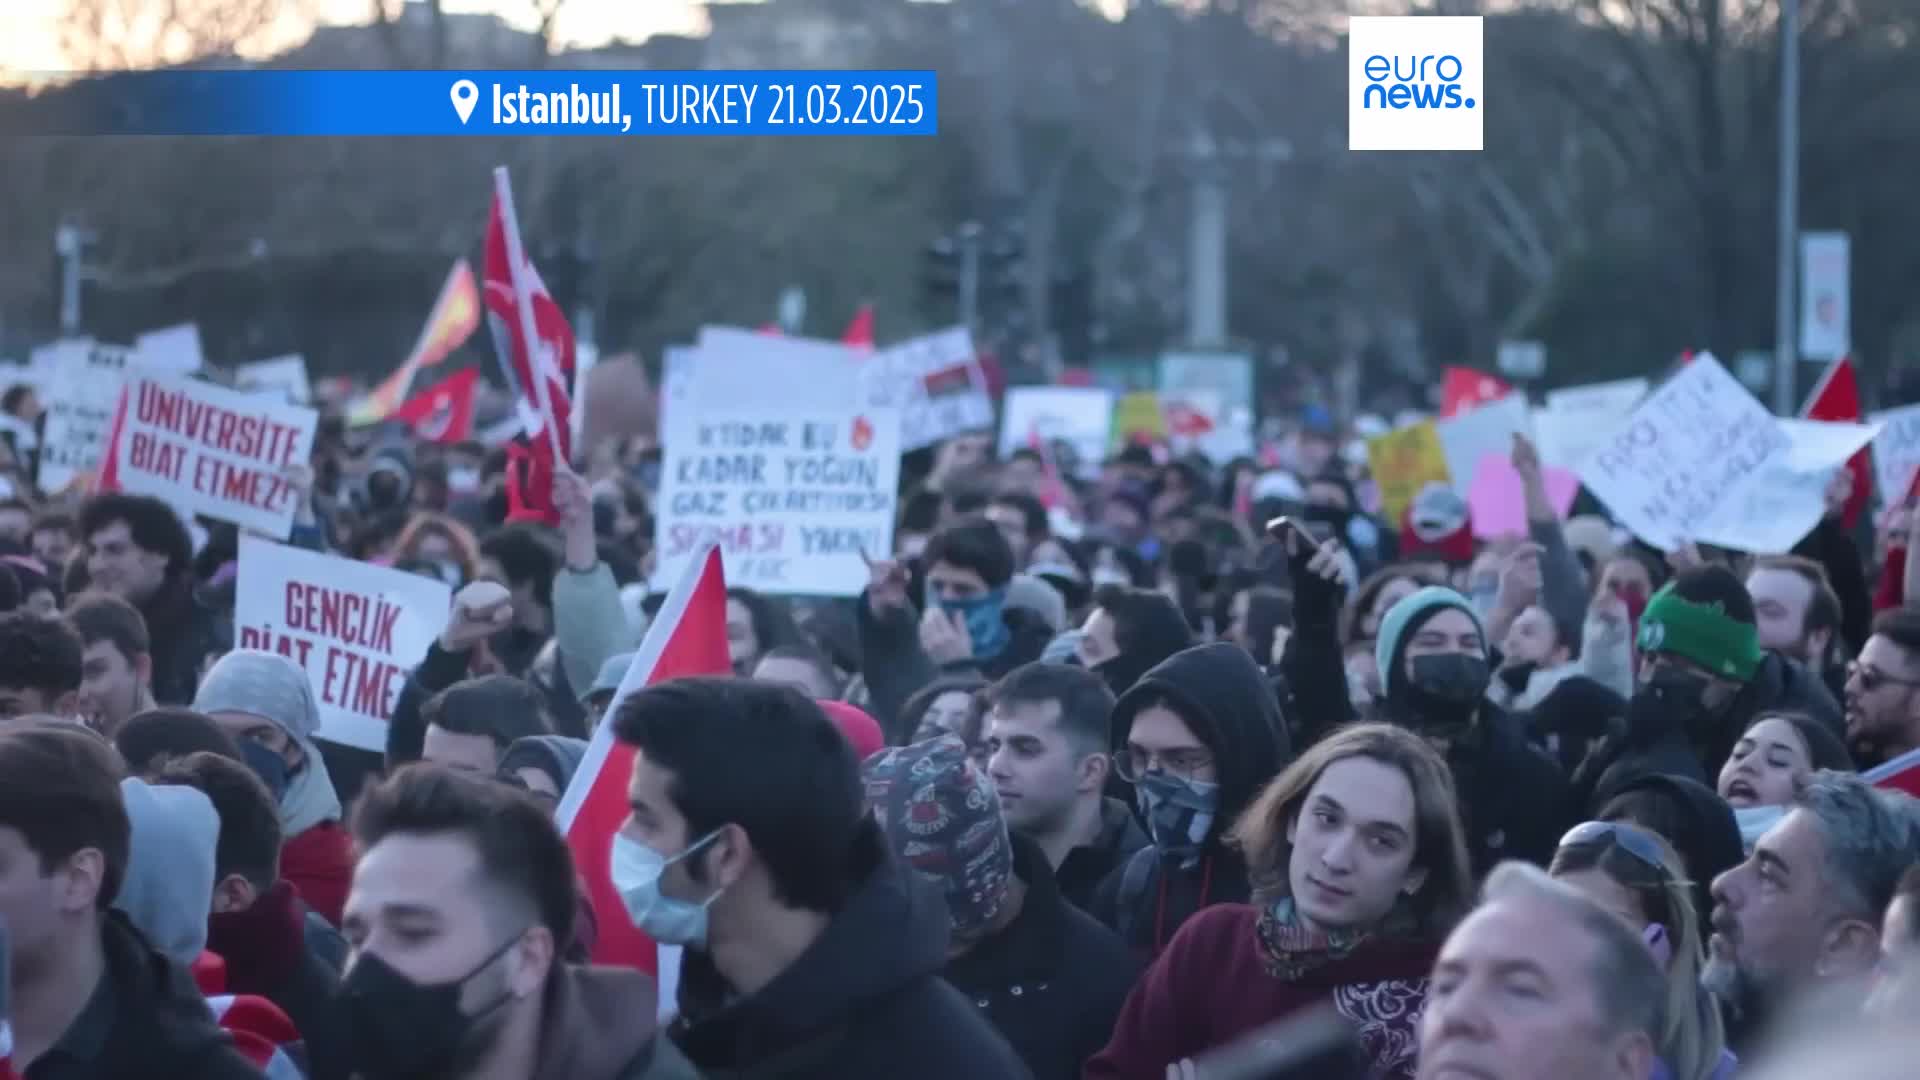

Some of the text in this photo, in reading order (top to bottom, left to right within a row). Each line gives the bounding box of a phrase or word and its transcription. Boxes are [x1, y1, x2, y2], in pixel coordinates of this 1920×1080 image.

[678, 453, 767, 484] KADAR
[671, 490, 728, 516] GAZ
[286, 580, 401, 655] GENÇLİK
[321, 646, 410, 720] ETME
